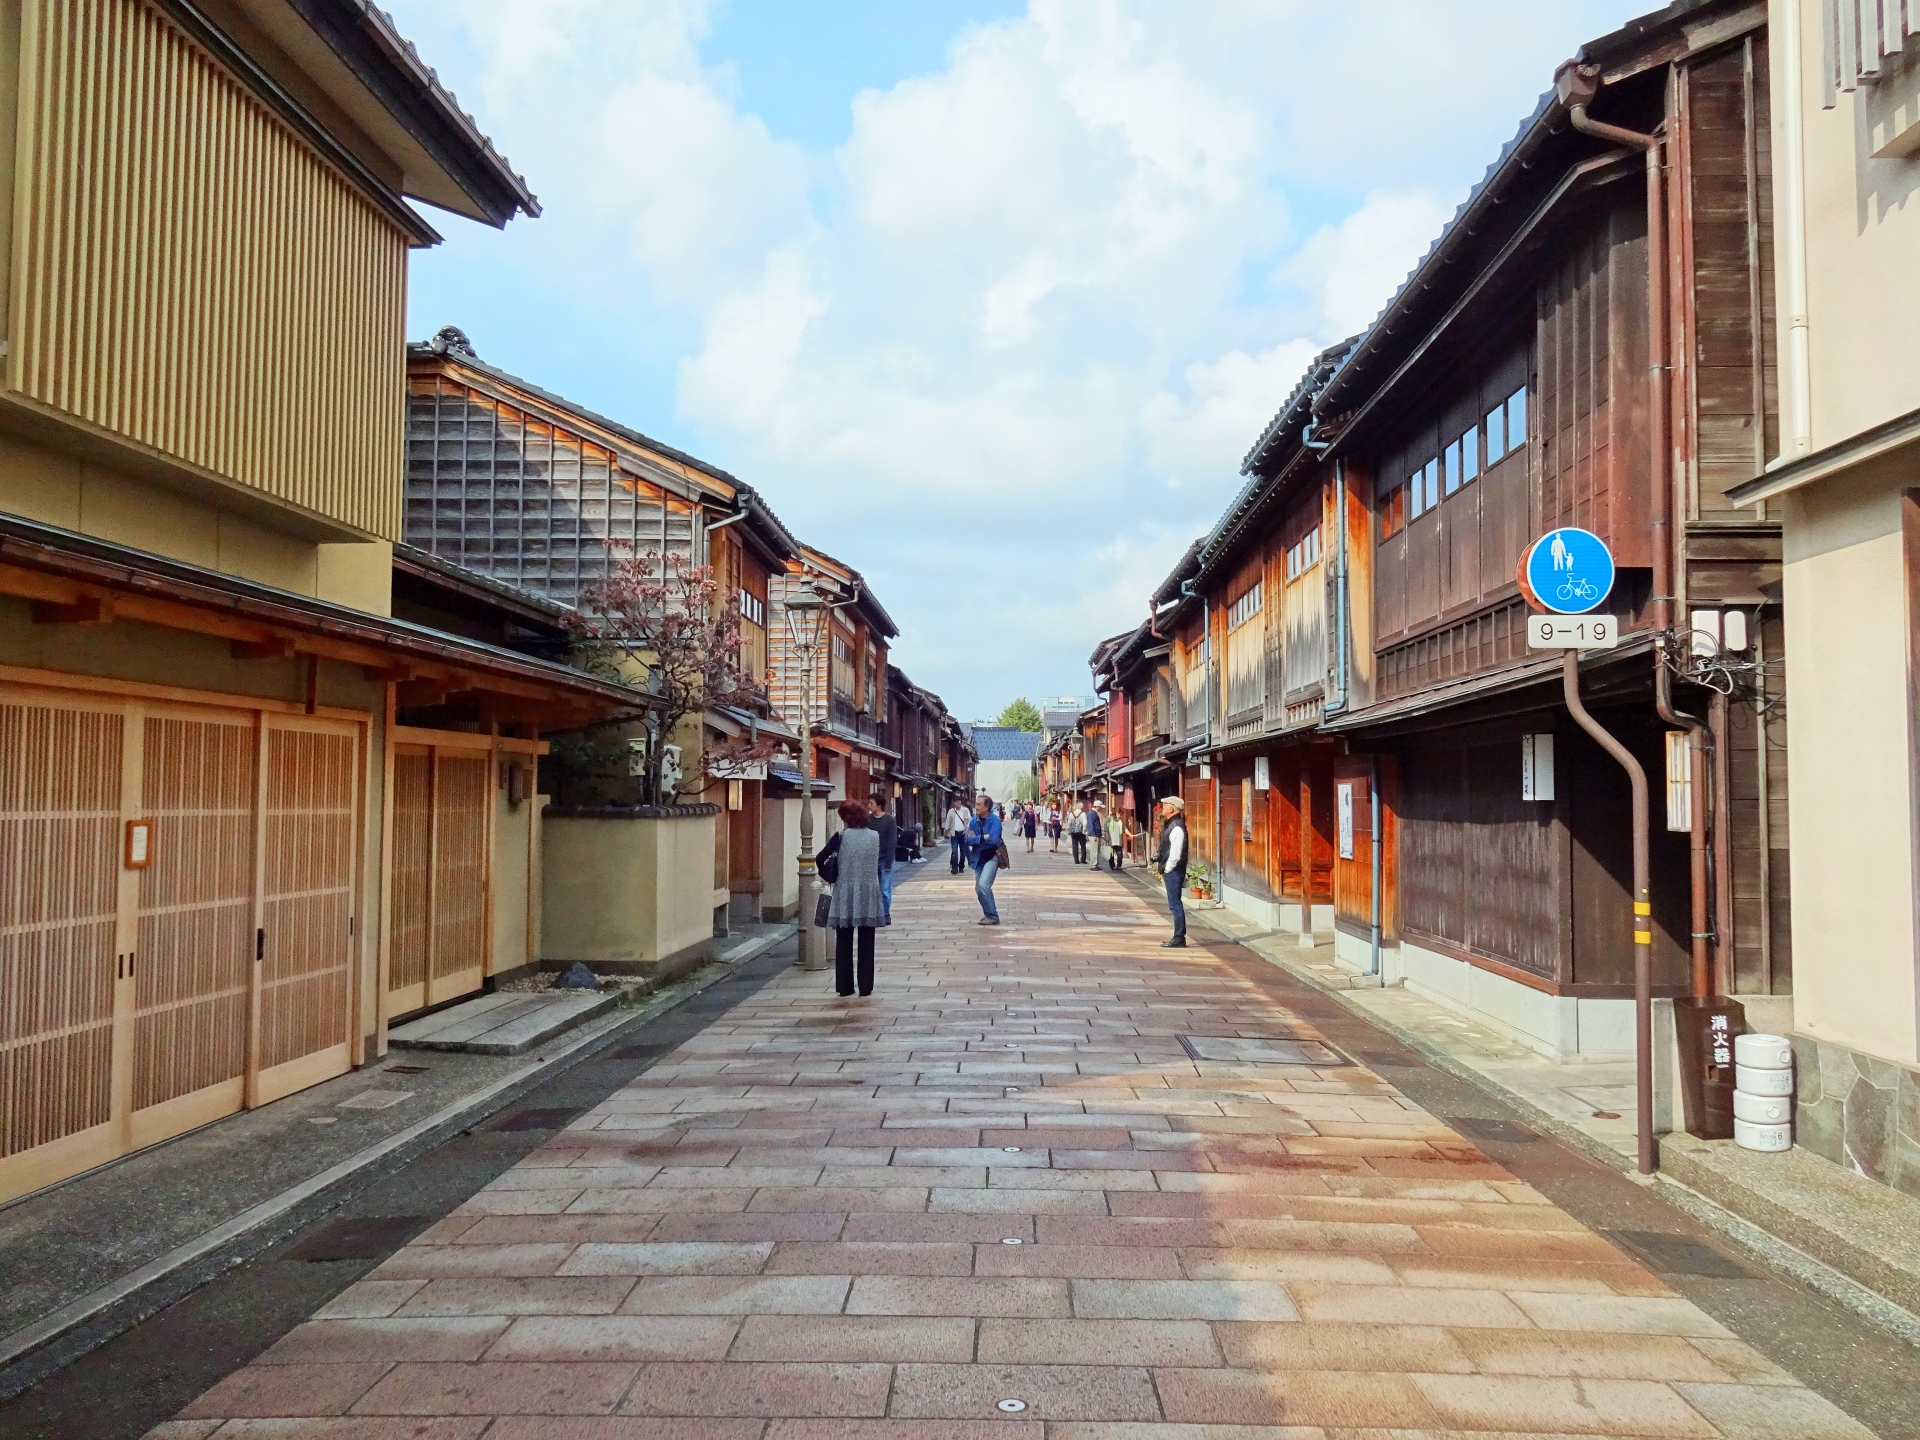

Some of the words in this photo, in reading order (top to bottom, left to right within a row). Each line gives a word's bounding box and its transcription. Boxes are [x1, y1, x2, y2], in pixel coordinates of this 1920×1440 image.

[1541, 623, 1606, 640] 9-19
[1711, 1015, 1730, 1063] 消火器
